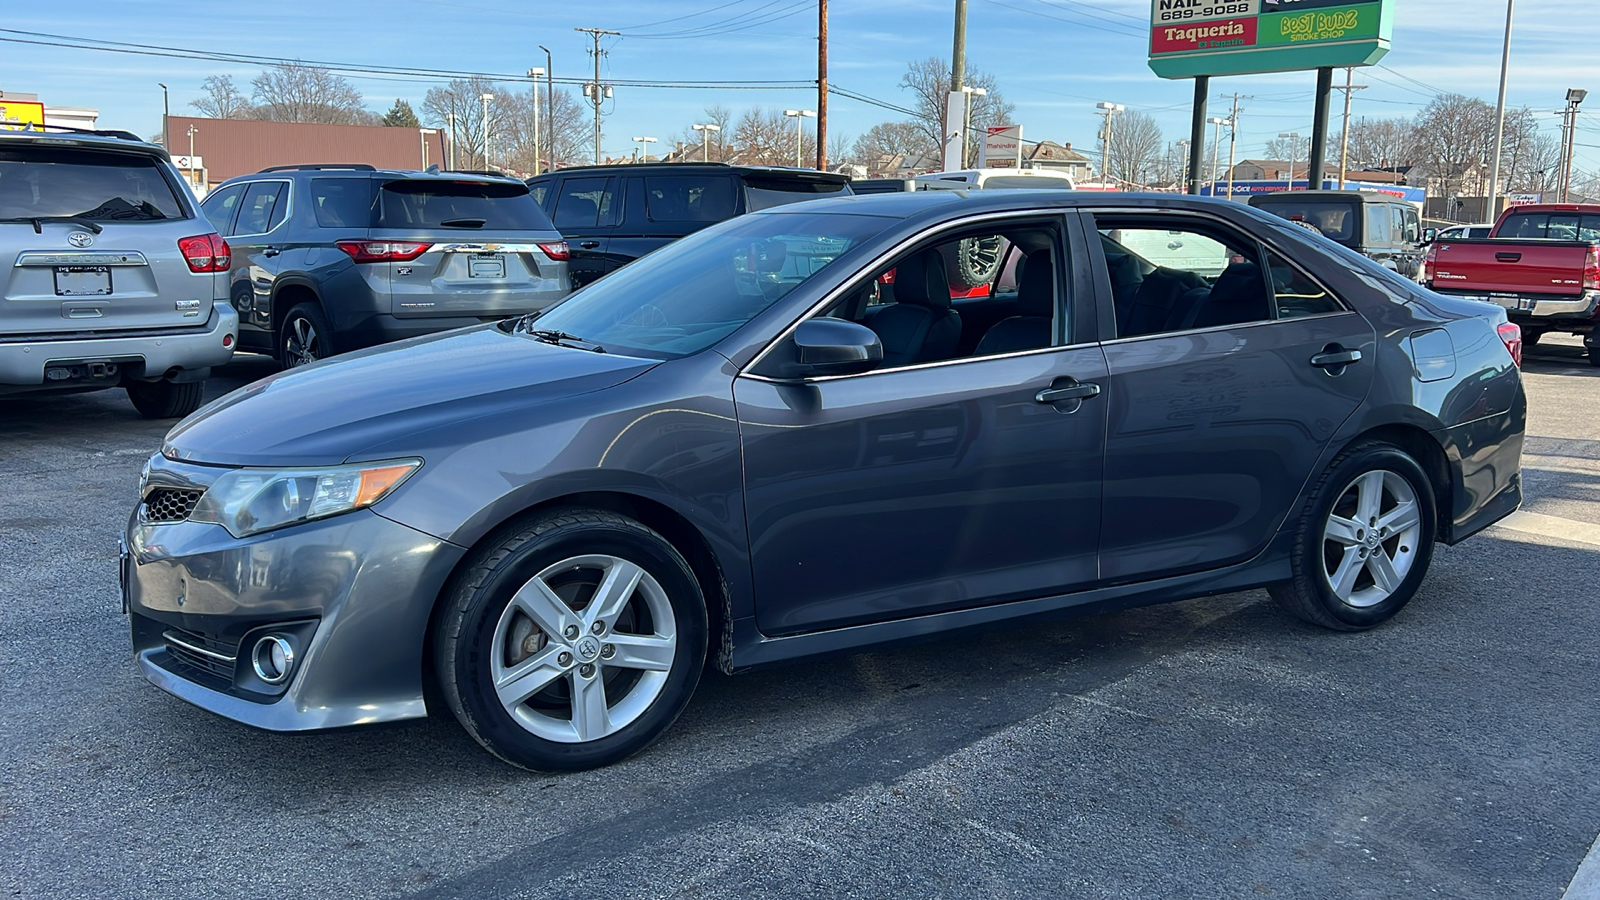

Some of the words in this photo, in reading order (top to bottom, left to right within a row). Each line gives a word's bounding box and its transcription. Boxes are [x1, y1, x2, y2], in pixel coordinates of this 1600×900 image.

[1160, 0, 1202, 10] NAIL
[1161, 3, 1249, 20] 689-9088
[1317, 10, 1358, 32] BUDZ
[1291, 31, 1319, 41] SMOKE
[1321, 30, 1344, 39] SHOP
[45, 255, 122, 263] SEQUOIA
